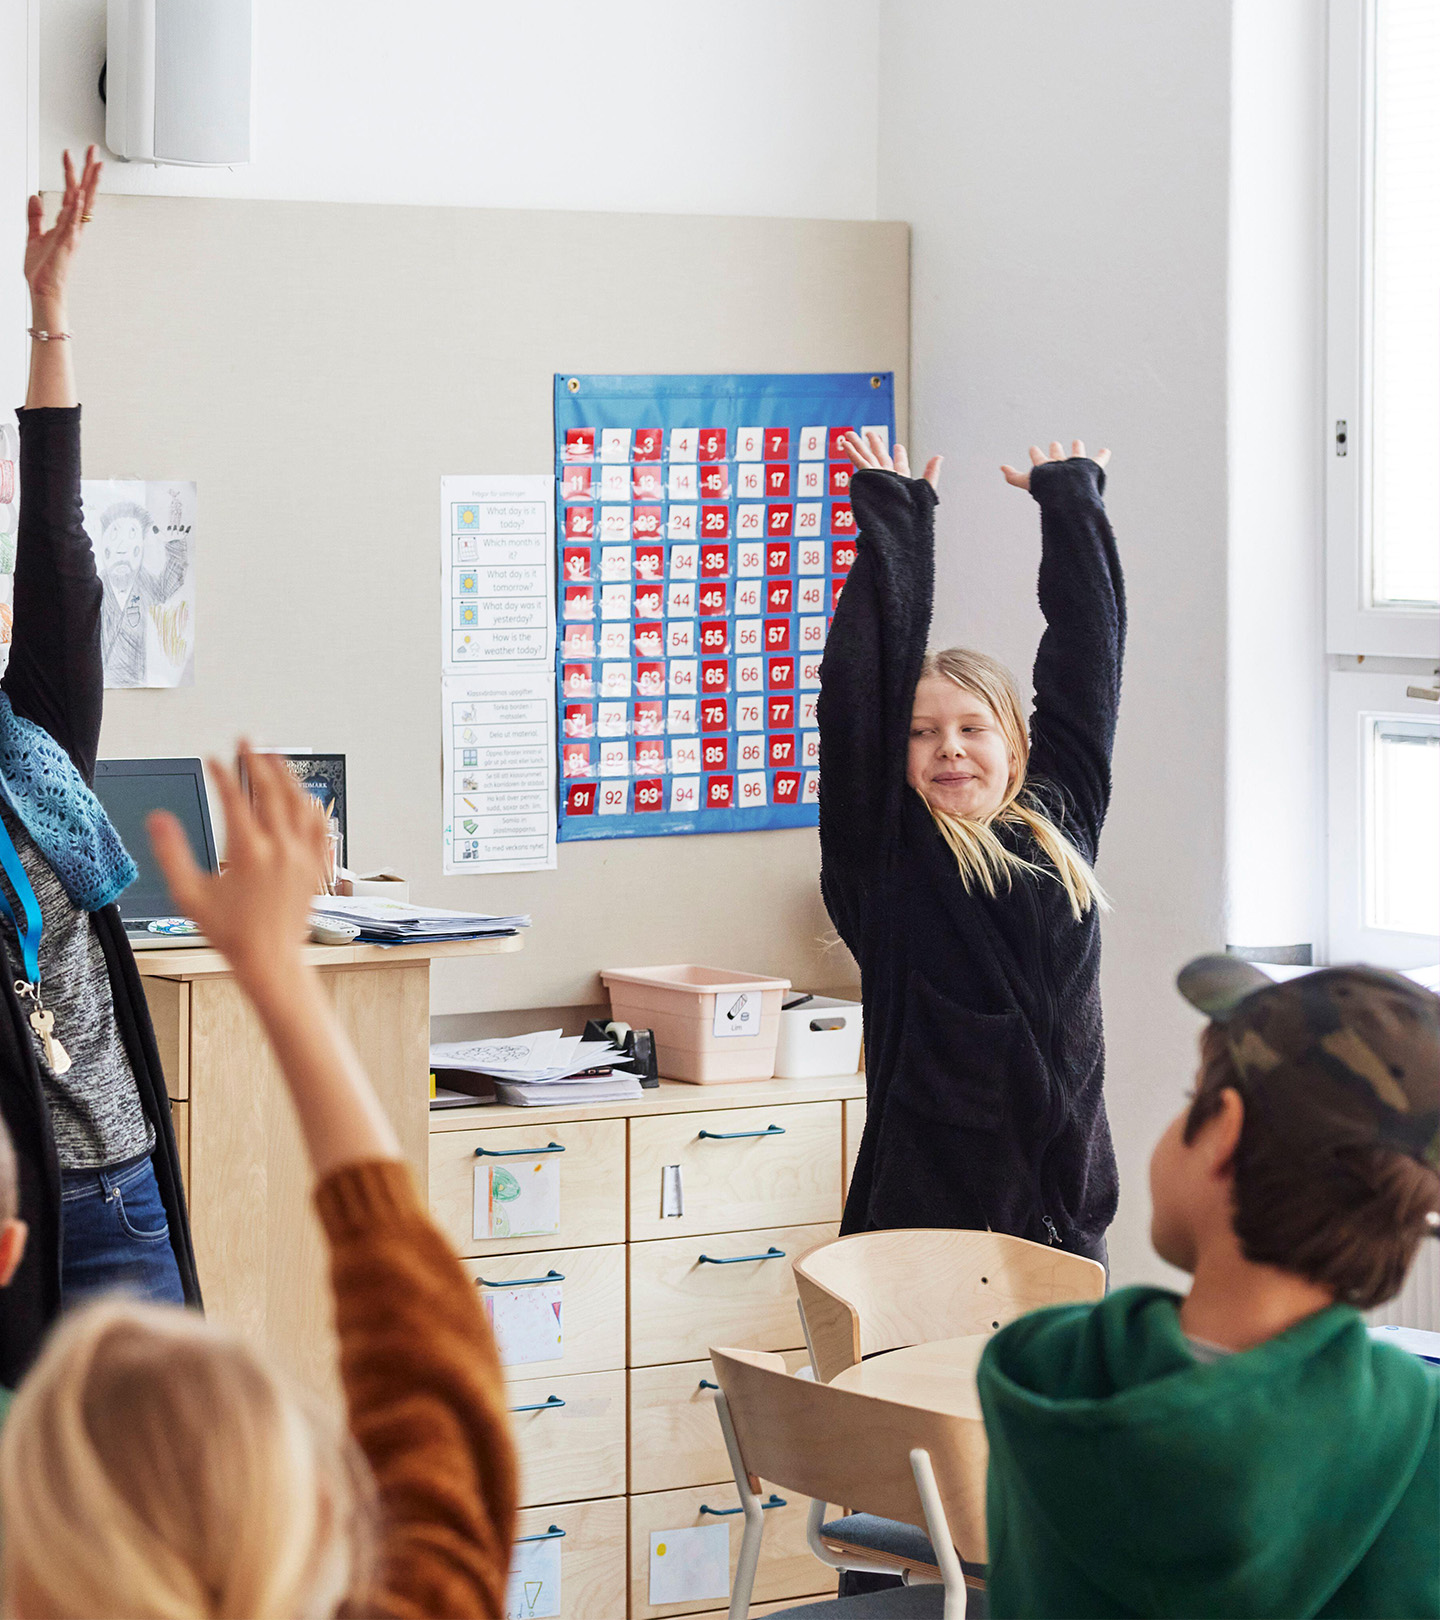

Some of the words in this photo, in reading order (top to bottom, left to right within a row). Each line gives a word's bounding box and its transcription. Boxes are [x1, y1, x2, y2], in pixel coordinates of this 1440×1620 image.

[644, 437, 654, 453] 3
[680, 439, 687, 451] 4
[708, 437, 718, 453] 5
[746, 438, 753, 451] 6
[772, 437, 782, 452] 7
[808, 437, 817, 450] 8
[837, 435, 846, 450] 9
[571, 476, 583, 491] 11
[610, 477, 622, 489] 12
[640, 475, 654, 491] 13
[677, 476, 689, 488] 14
[707, 475, 722, 490] 15
[745, 475, 757, 488] 16
[771, 472, 785, 488] 17
[806, 473, 817, 486] 18
[834, 472, 849, 487] 19
[509, 507, 521, 517] day
[500, 520, 524, 529] today?
[572, 516, 587, 532] 21
[607, 517, 624, 531] 22
[674, 516, 690, 530] 24
[706, 514, 724, 530] 25
[743, 515, 758, 528] 26
[771, 512, 789, 528] 27
[801, 513, 816, 526] 28
[835, 511, 853, 527] 29
[483, 539, 507, 547] Which
[676, 556, 692, 569] 34
[705, 553, 724, 569] 35
[743, 553, 759, 567] 36
[770, 551, 786, 567] 37
[803, 551, 819, 565] 38
[836, 550, 855, 565] 39
[487, 570, 507, 578] What
[510, 570, 522, 580] day
[493, 583, 533, 591] tomorrow?
[483, 602, 502, 610] What
[505, 602, 518, 611] day
[674, 594, 689, 606] 44
[703, 592, 722, 607] 45
[741, 591, 756, 605] 46
[770, 589, 789, 605] 47
[803, 589, 819, 603] 48
[493, 615, 533, 624] yesterday?
[571, 634, 586, 649] 51
[607, 634, 624, 648] 52
[672, 633, 688, 646] 54
[705, 630, 724, 646] 55
[741, 630, 756, 644] 56
[768, 627, 785, 643] 57
[805, 627, 821, 641] 58
[484, 647, 515, 655] weather
[517, 646, 542, 655] today?
[570, 673, 586, 688] 61
[641, 671, 660, 686] 63
[675, 671, 691, 684] 64
[705, 669, 724, 684] 65
[742, 668, 758, 681] 66
[771, 666, 790, 682] 67
[605, 713, 621, 726] 72
[674, 710, 690, 723] 74
[705, 707, 723, 723] 75
[742, 707, 758, 721] 76
[772, 705, 790, 720] 77
[607, 752, 623, 767] 82
[677, 750, 695, 763] 84
[705, 747, 723, 763] 85
[743, 746, 760, 759] 86
[773, 743, 791, 759] 87
[574, 792, 589, 807] 91
[605, 791, 622, 804] 92
[639, 788, 658, 804] 93
[676, 788, 693, 801] 94
[711, 785, 729, 800] 95
[744, 783, 761, 797] 96
[778, 780, 796, 795] 97
